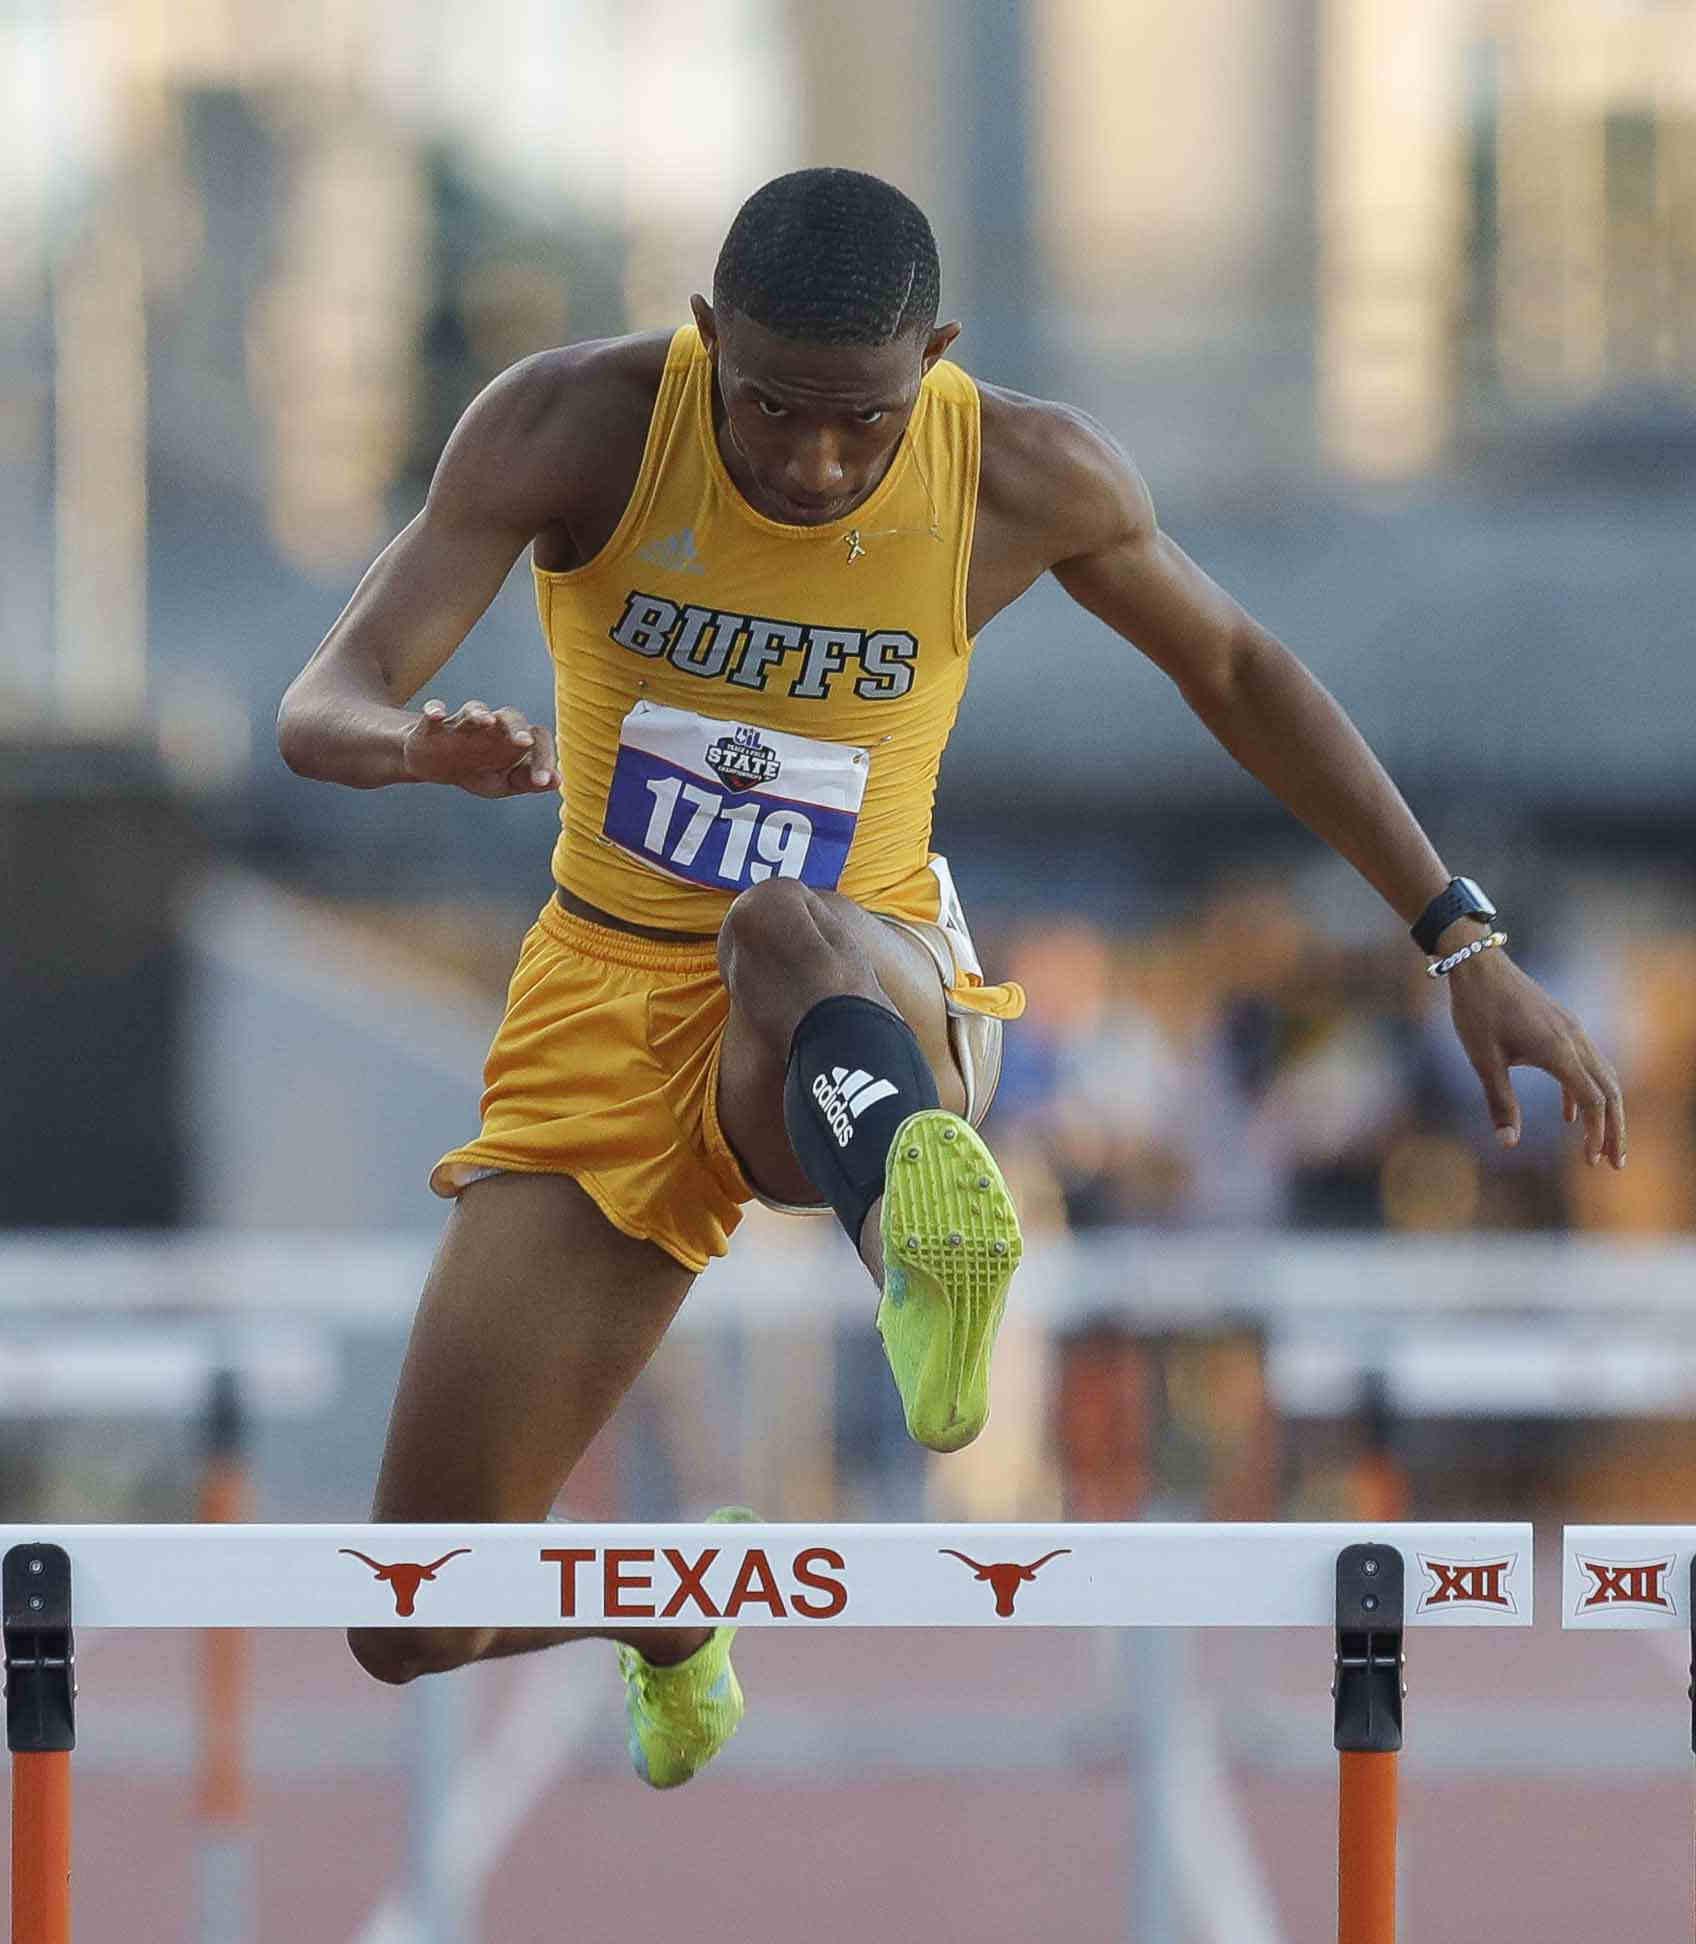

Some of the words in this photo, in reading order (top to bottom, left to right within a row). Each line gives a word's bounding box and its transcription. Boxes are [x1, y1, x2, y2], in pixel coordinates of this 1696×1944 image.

[608, 590, 919, 700] BUFFS
[707, 747, 779, 778] STATE
[643, 776, 813, 885] 1719
[812, 1073, 854, 1148] adidas
[540, 1548, 848, 1619] TEXAS
[1426, 1562, 1509, 1606] XII
[1584, 1562, 1669, 1607] XII
